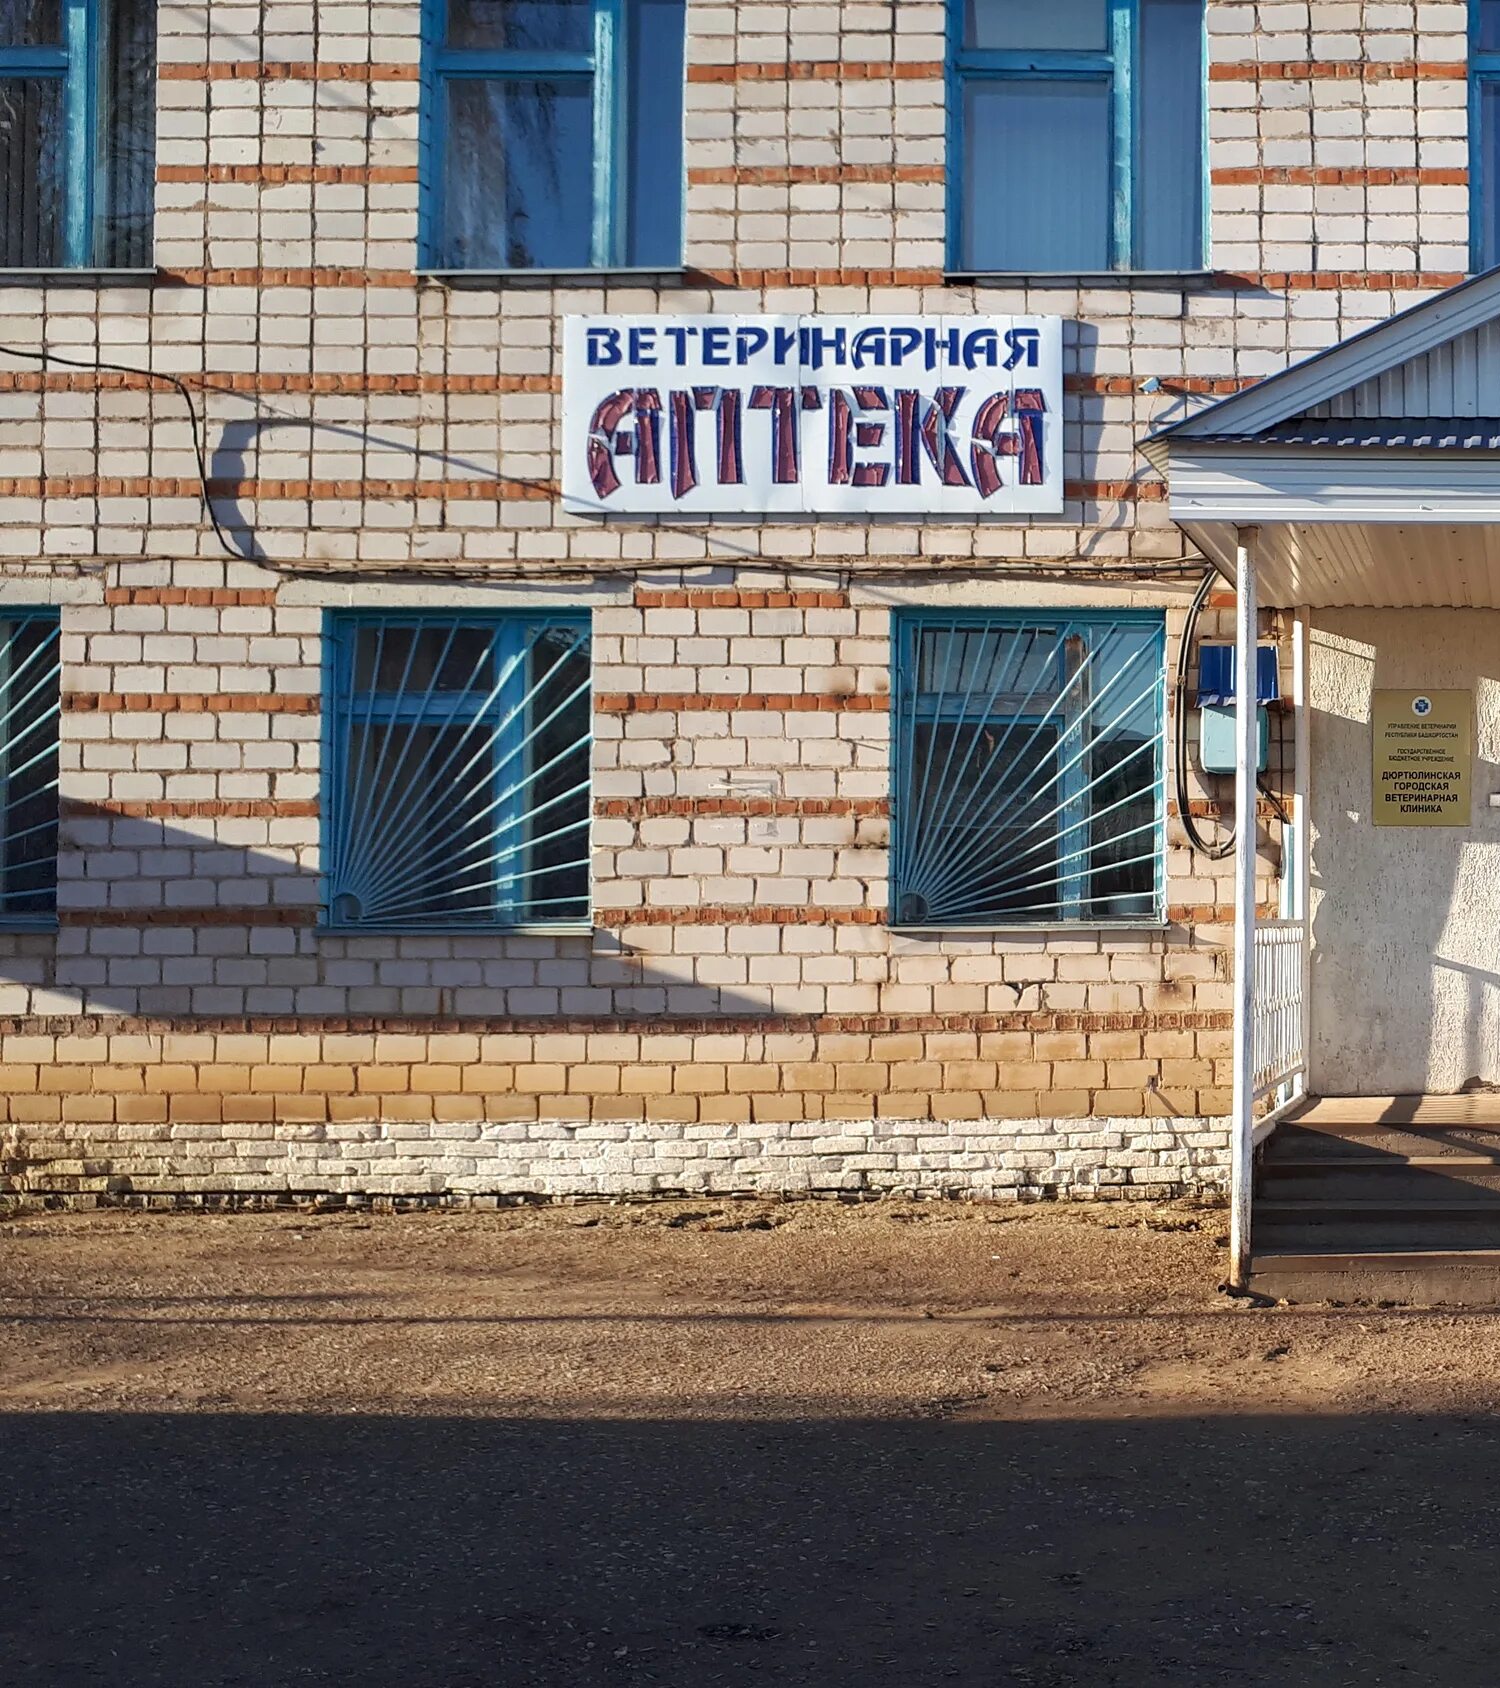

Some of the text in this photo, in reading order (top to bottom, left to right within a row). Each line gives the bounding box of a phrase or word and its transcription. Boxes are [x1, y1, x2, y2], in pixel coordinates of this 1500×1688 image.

[585, 326, 1041, 371] ВЕТЕРИНАРНАЯ
[586, 386, 1048, 500] АПТЕКА
[1381, 771, 1461, 780] ДЮРТЮЛИНСКАЯ
[1394, 782, 1449, 791] ГОРОДСКАЯ
[1385, 793, 1458, 802] ВЕТЕРИНАРНАЯ
[1400, 804, 1443, 813] КЛИНИКА
